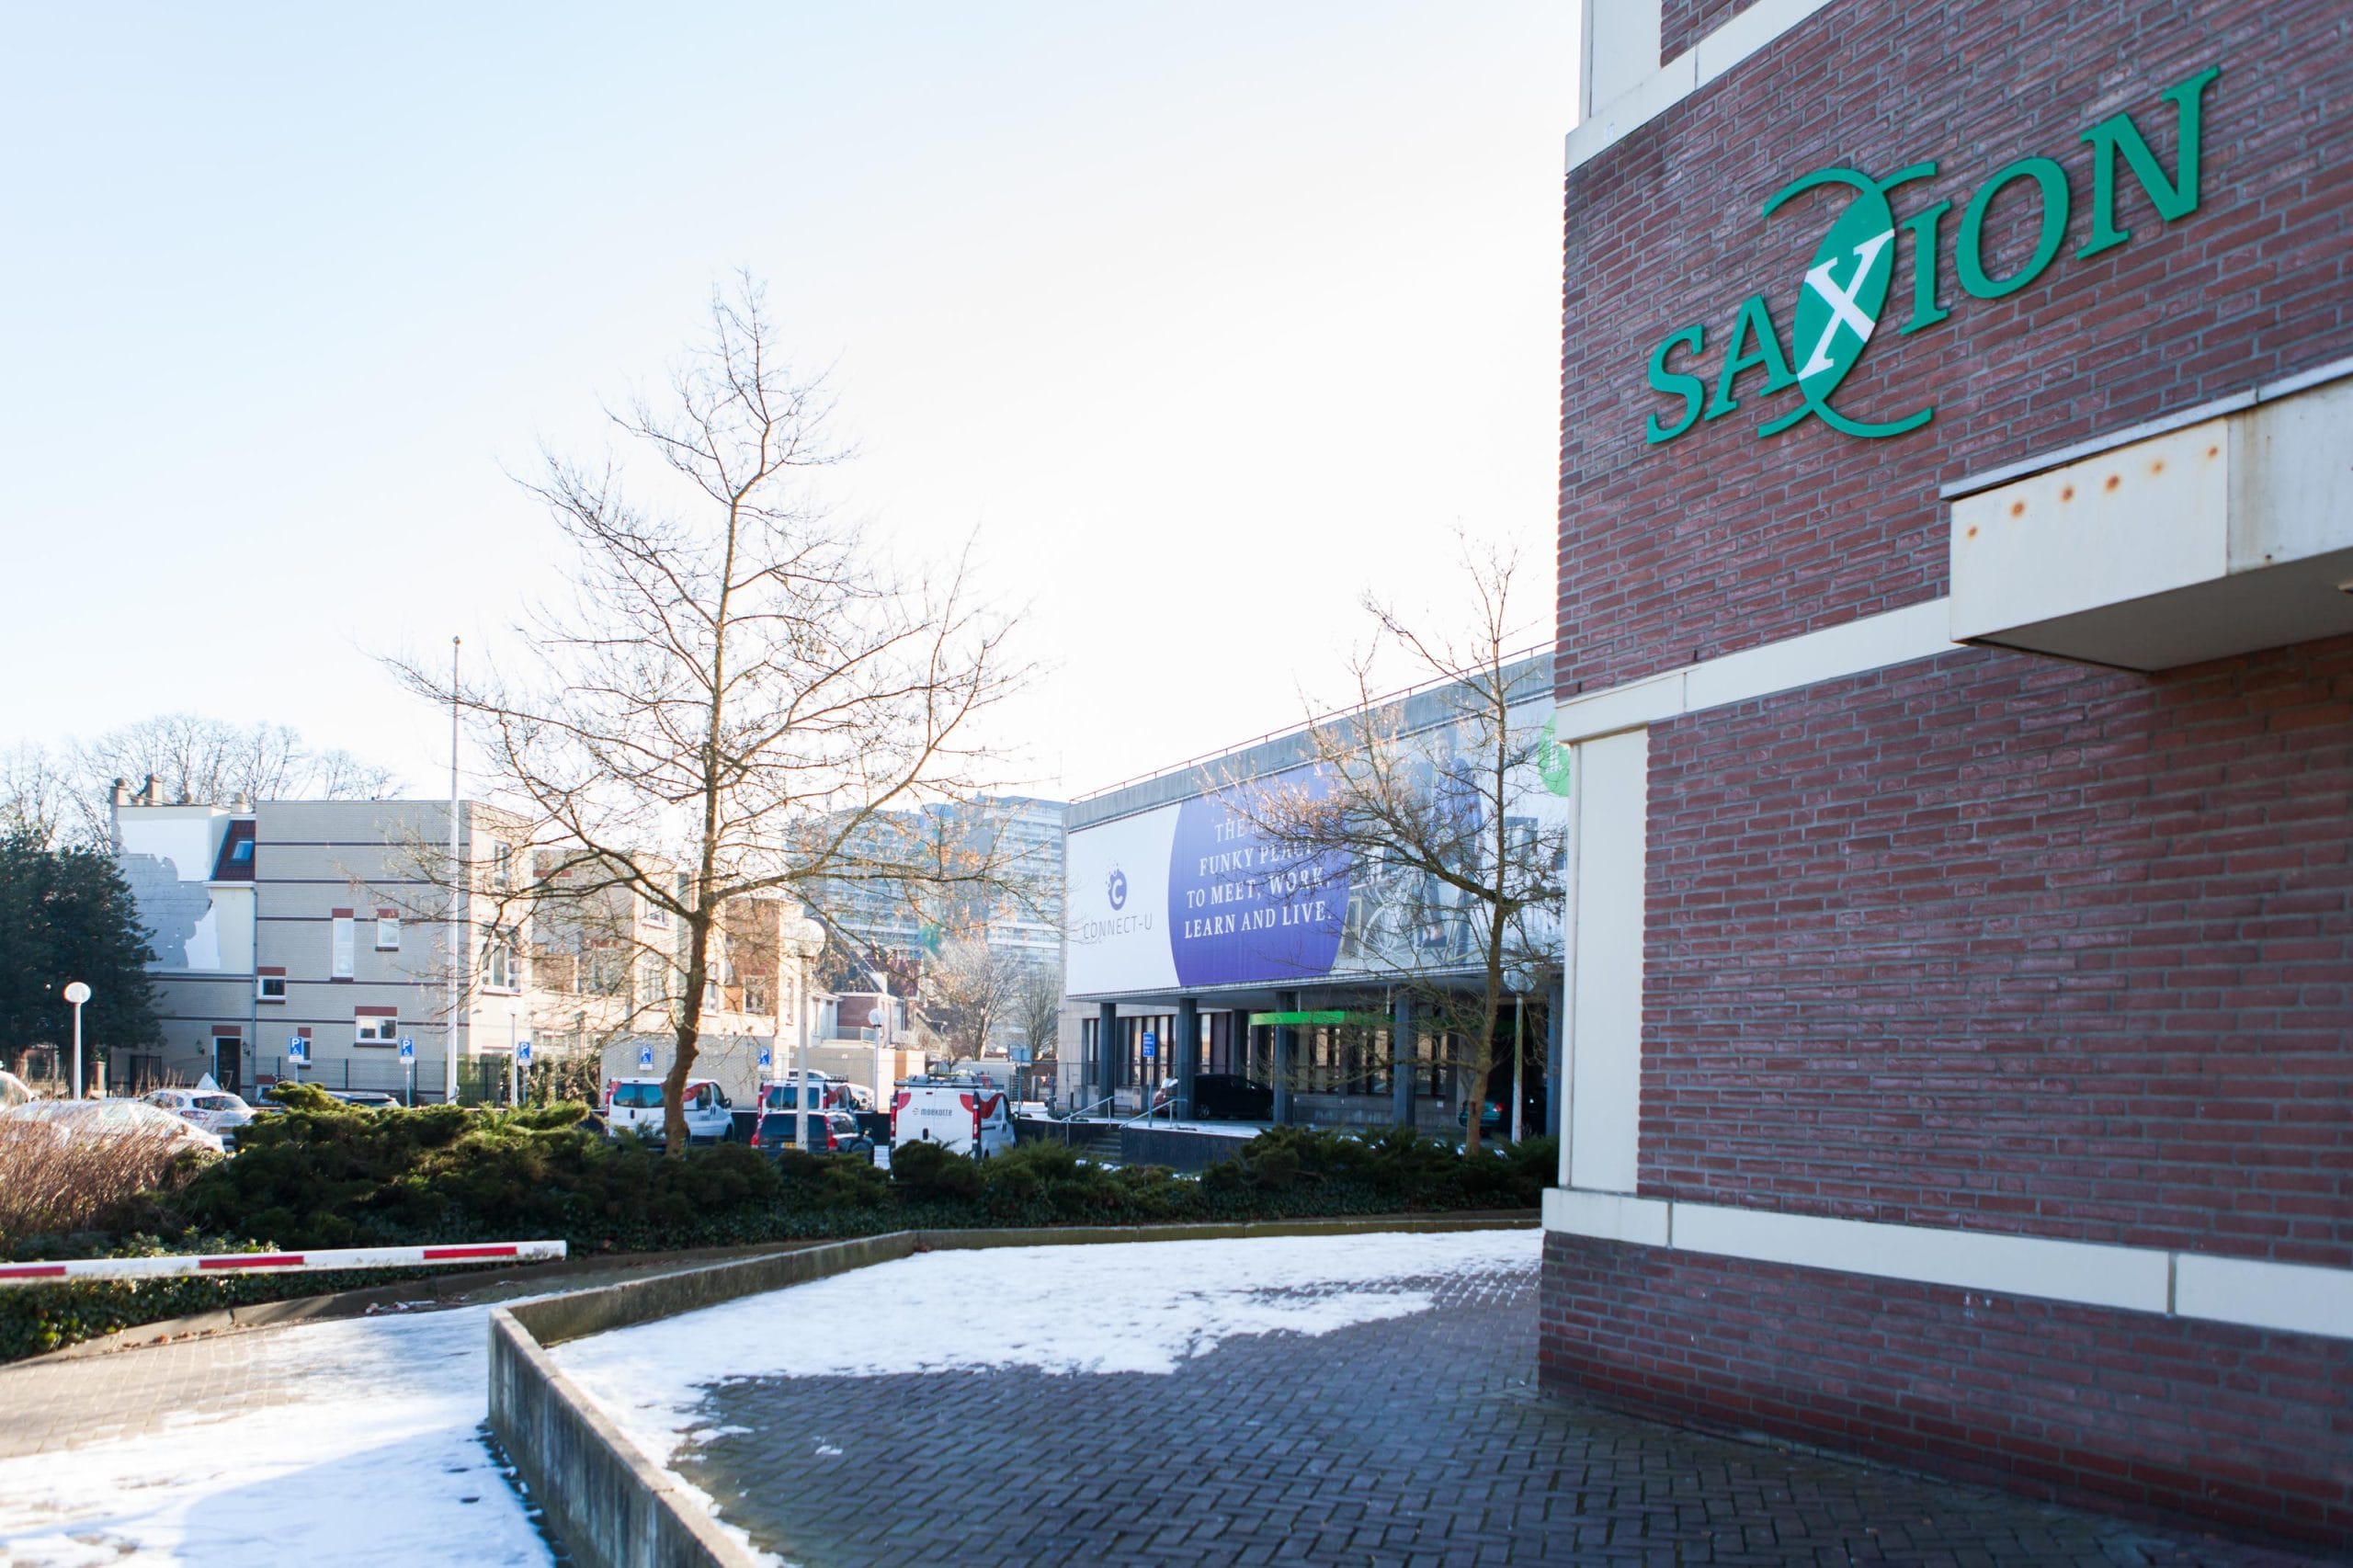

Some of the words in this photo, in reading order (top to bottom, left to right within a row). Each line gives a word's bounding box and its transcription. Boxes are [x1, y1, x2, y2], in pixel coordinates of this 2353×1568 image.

[1646, 65, 2220, 445] SAXION
[1215, 819, 1245, 843] THE
[1199, 846, 1254, 877] FUNKY
[1187, 890, 1205, 909] TO
[1210, 879, 1262, 905] MEET,
[1083, 912, 1153, 939] CONNECT-U
[1184, 914, 1236, 939] LEARN
[1241, 908, 1276, 932] AND
[1282, 900, 1332, 926] LIVE.
